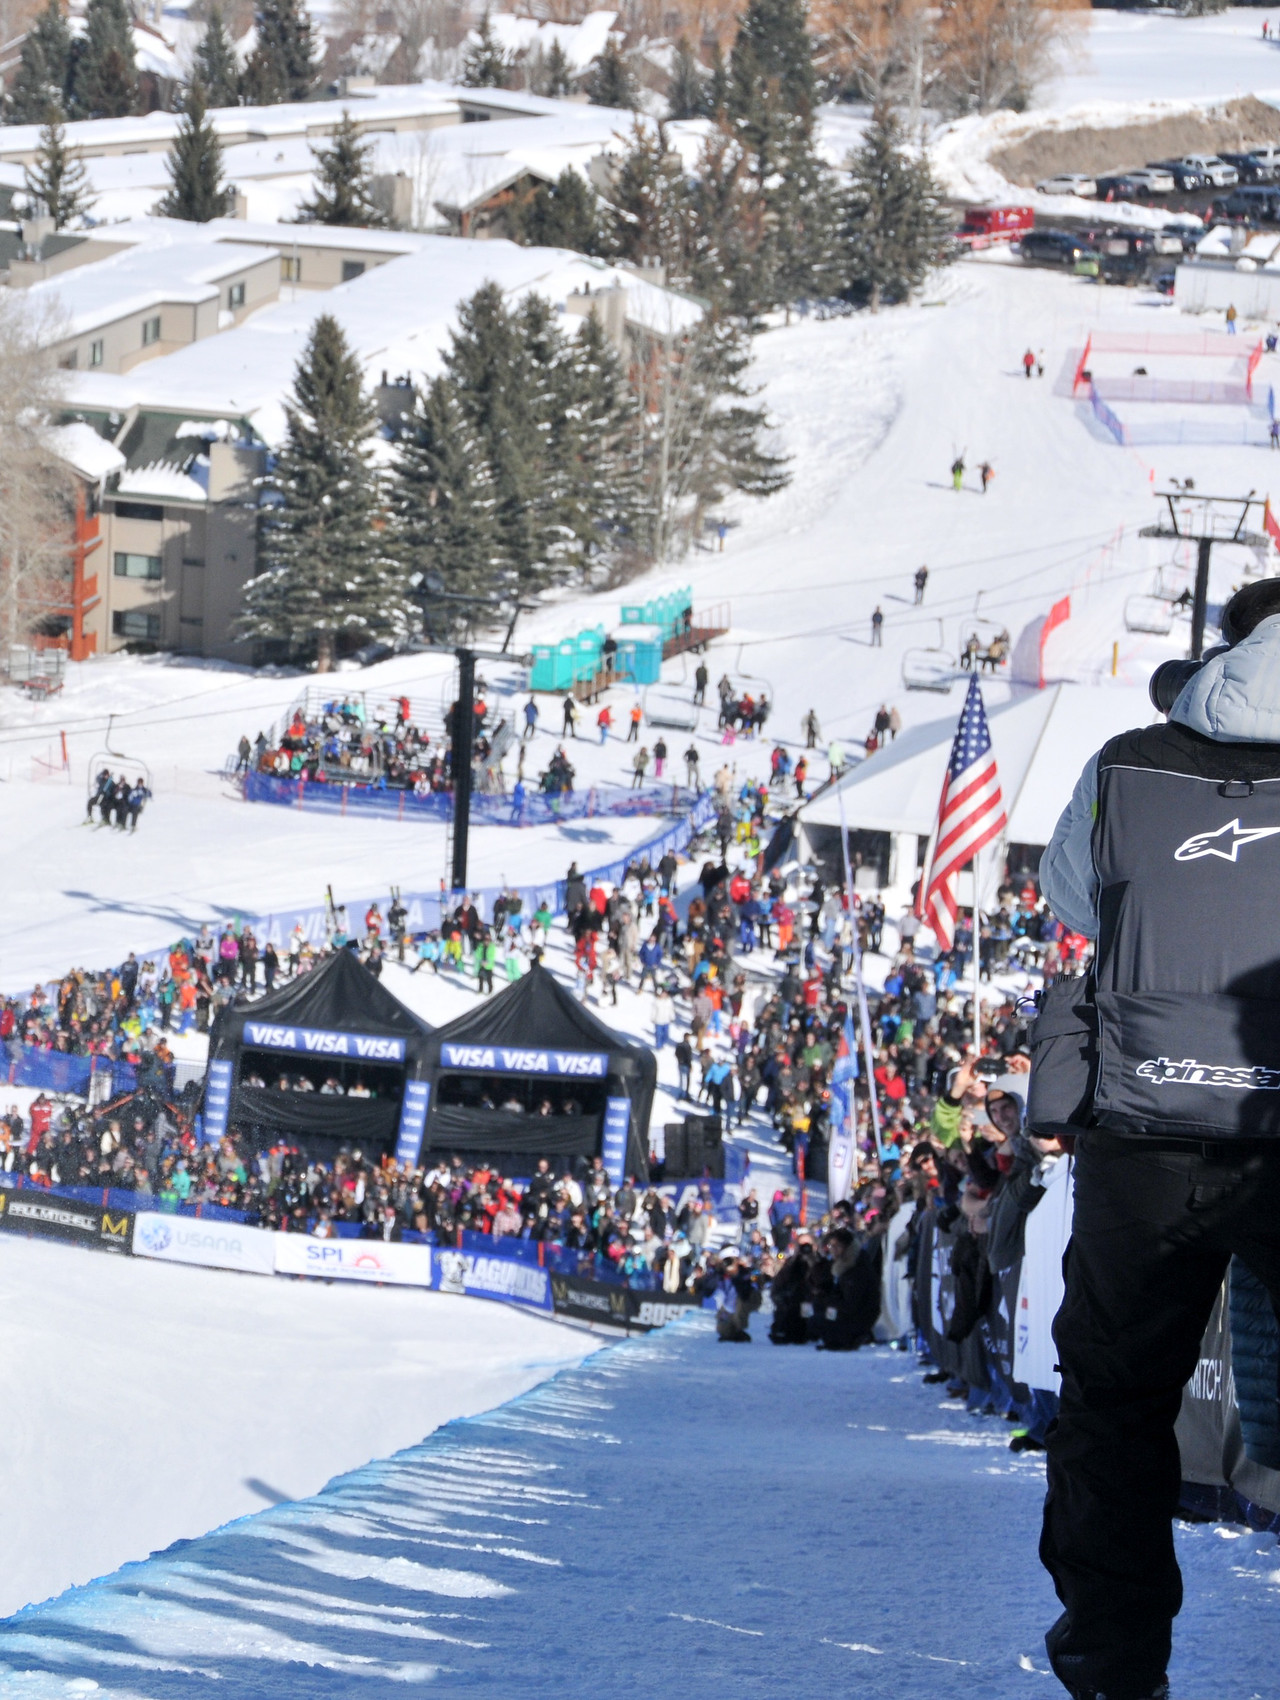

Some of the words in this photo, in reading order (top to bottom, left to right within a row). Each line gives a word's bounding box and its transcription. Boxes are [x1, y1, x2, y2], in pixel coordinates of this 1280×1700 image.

[249, 1025, 296, 1048] VISA
[301, 1031, 349, 1054] VISA
[354, 1037, 401, 1060] VISA
[447, 1047, 495, 1068] VISA
[501, 1050, 549, 1072] VISA
[554, 1054, 603, 1076] VISA
[176, 1230, 243, 1254] USANA
[306, 1245, 342, 1262] SPI
